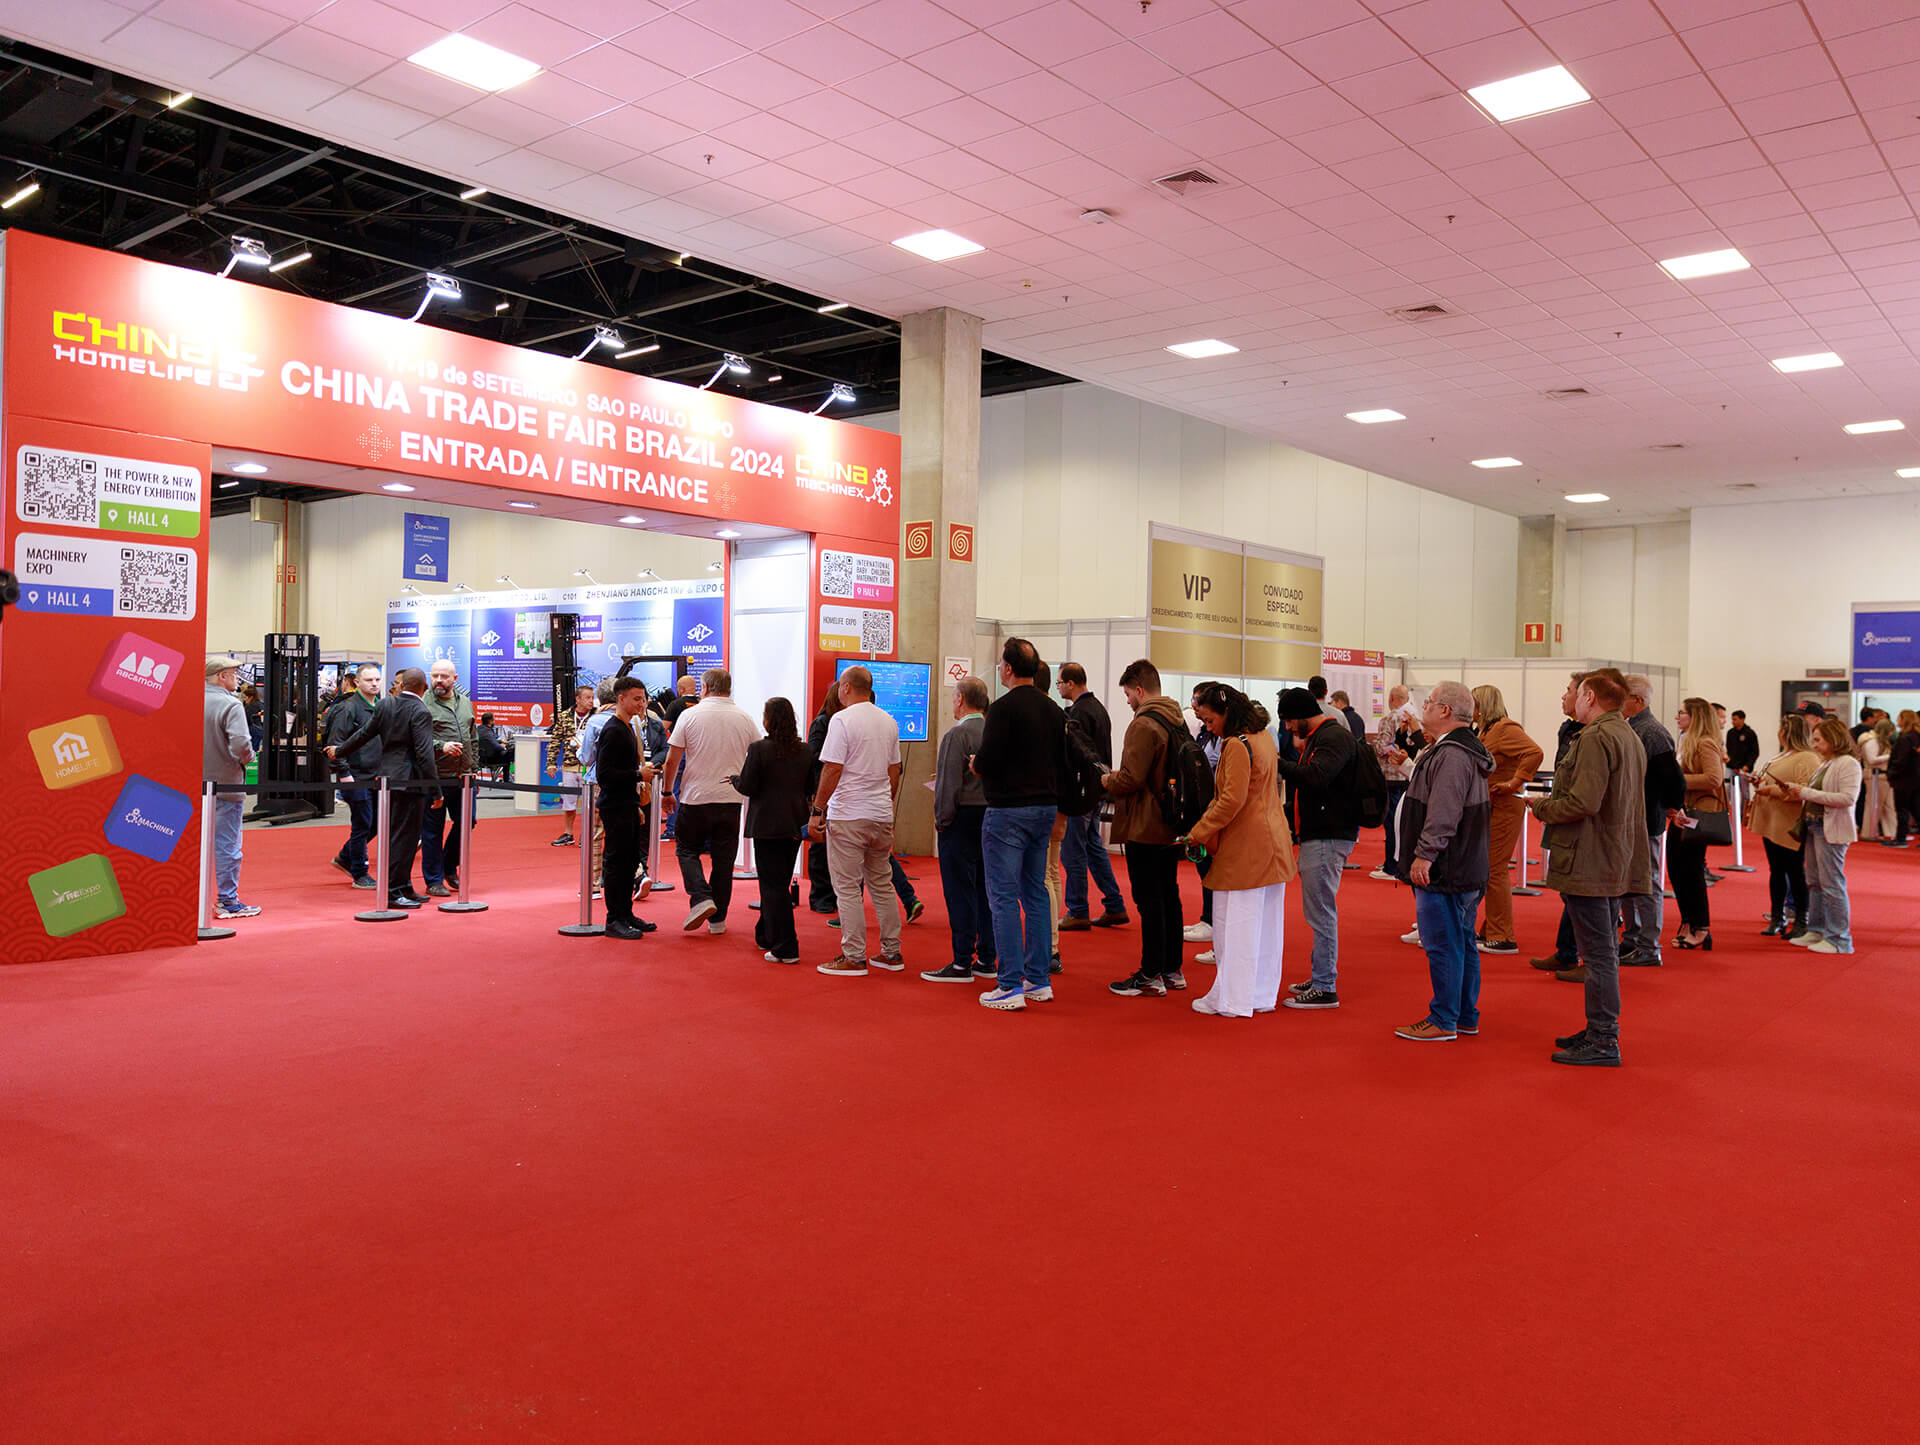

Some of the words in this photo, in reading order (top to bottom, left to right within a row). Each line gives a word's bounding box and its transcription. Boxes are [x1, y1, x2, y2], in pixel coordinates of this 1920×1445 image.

[442, 365, 468, 386] de
[472, 370, 578, 407] SETEMBRO
[630, 402, 687, 429] PAULO
[280, 360, 411, 414] CHINA
[419, 385, 538, 436] TRADE
[547, 410, 617, 450] FAIR
[626, 425, 724, 469] BRAZIL
[730, 446, 785, 479] 2024
[400, 430, 549, 481] ENTRADA
[554, 457, 564, 482] /
[571, 458, 709, 504] ENTRANCE
[104, 466, 122, 480] THE
[125, 469, 159, 484] POWER
[162, 474, 170, 485] &
[172, 476, 193, 488] NEW
[104, 481, 142, 496] ENERGY
[144, 486, 197, 502] EXHIBITION
[128, 510, 158, 527] HALL
[161, 514, 169, 528] 4
[26, 548, 87, 564] MACHINERY
[856, 559, 890, 569] INTERNATIONAL
[26, 562, 53, 575] EXPO
[586, 588, 629, 600] ZHENJIANG
[630, 586, 669, 597] HANGCHA
[862, 587, 874, 597] HALL
[875, 589, 880, 597] 4
[1183, 573, 1212, 602] VIP
[1263, 584, 1304, 600] CONVIDADO
[47, 591, 79, 607] HALL
[82, 594, 91, 608] 4
[1266, 600, 1300, 615] ESPECIAL
[681, 645, 718, 654] HANGCHA
[55, 758, 99, 779] HOMELIFE
[138, 816, 175, 837] MACHINEX
